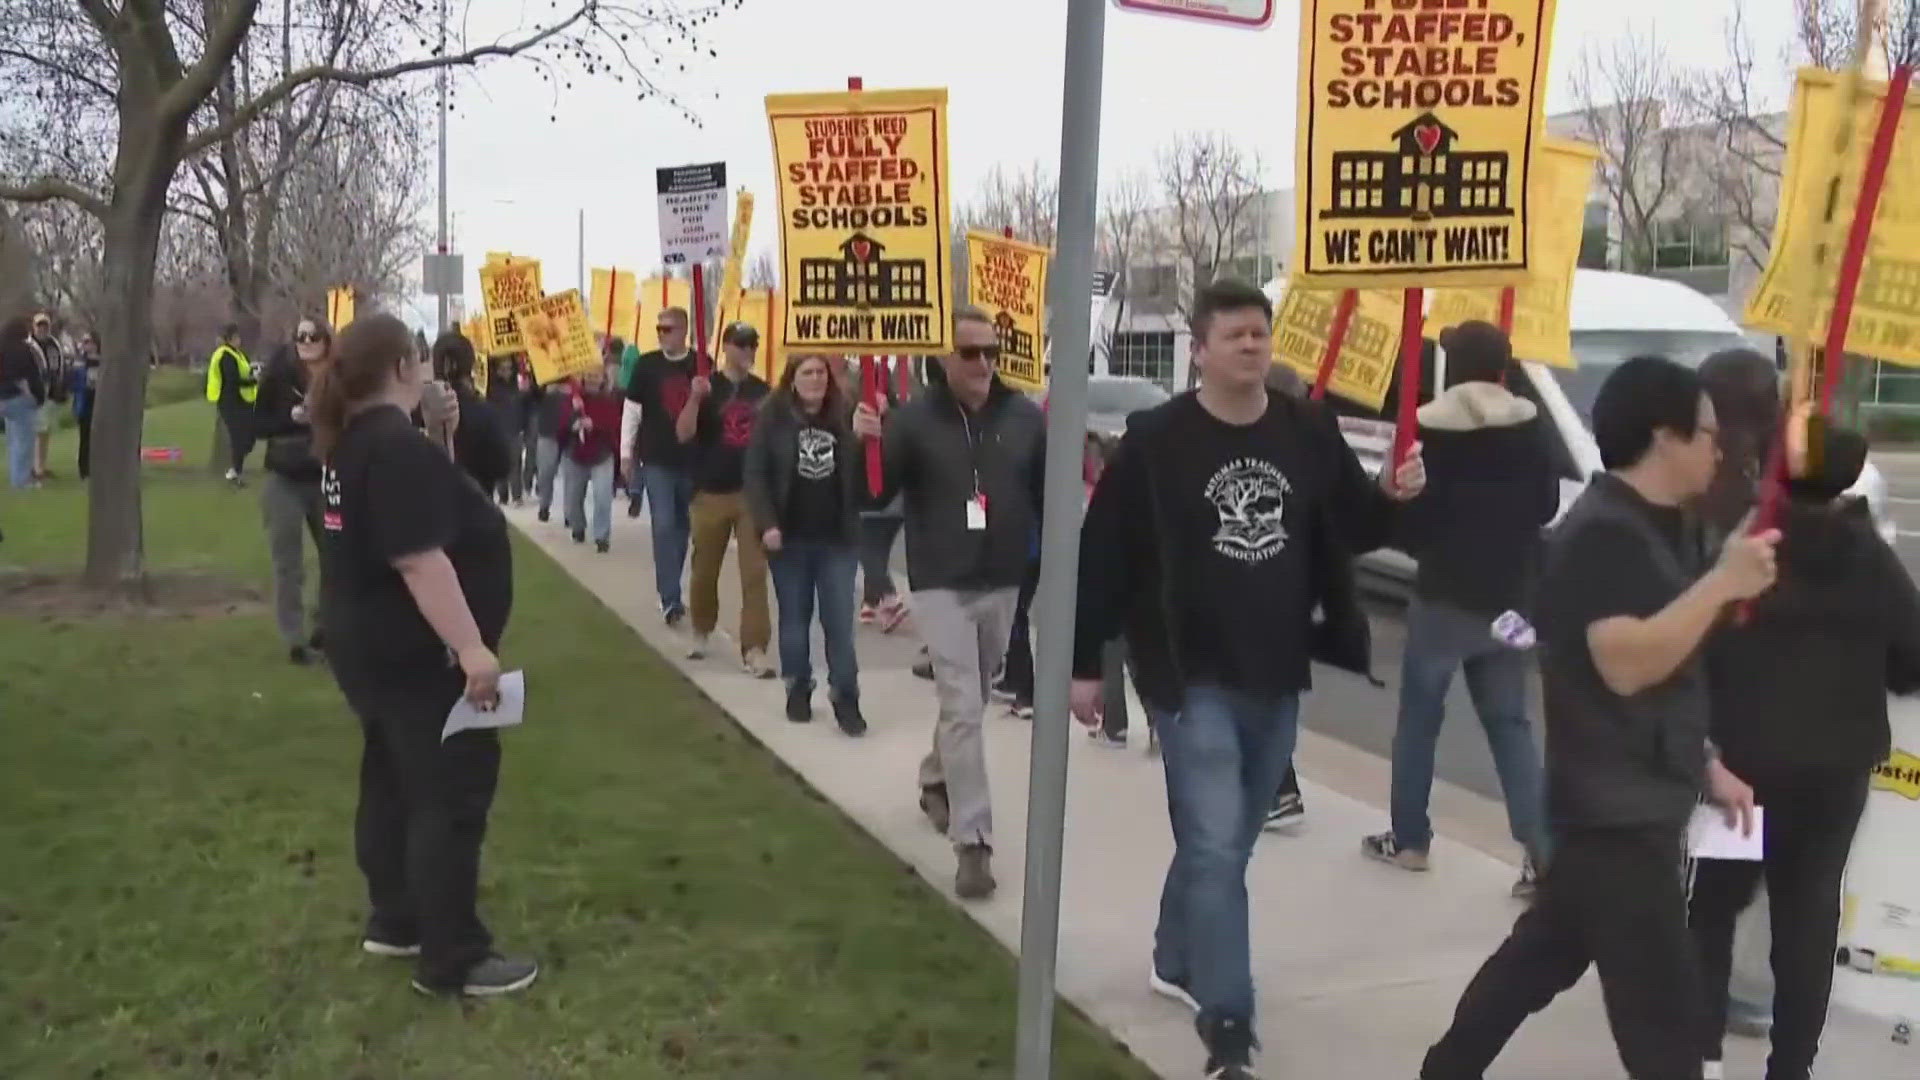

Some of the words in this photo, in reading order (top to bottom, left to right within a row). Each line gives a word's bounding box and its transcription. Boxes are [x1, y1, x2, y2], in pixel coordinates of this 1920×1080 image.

[1329, 13, 1525, 47] STAFFED,
[1340, 46, 1499, 76] STABLE
[1327, 78, 1520, 109] SCHOOLS
[804, 117, 869, 139] STUDENTS
[873, 116, 908, 136] NEED
[808, 136, 903, 159] FULLY
[788, 158, 926, 184] STAFFED,
[799, 182, 912, 207] STABLE
[792, 206, 928, 229] SCHOOLS
[1324, 229, 1361, 264] WE
[1368, 228, 1437, 264] CAN'T
[1444, 225, 1509, 262] WAIT!
[795, 314, 822, 339] WE
[826, 313, 876, 341] CAN'T
[880, 314, 930, 341] WAIT!
